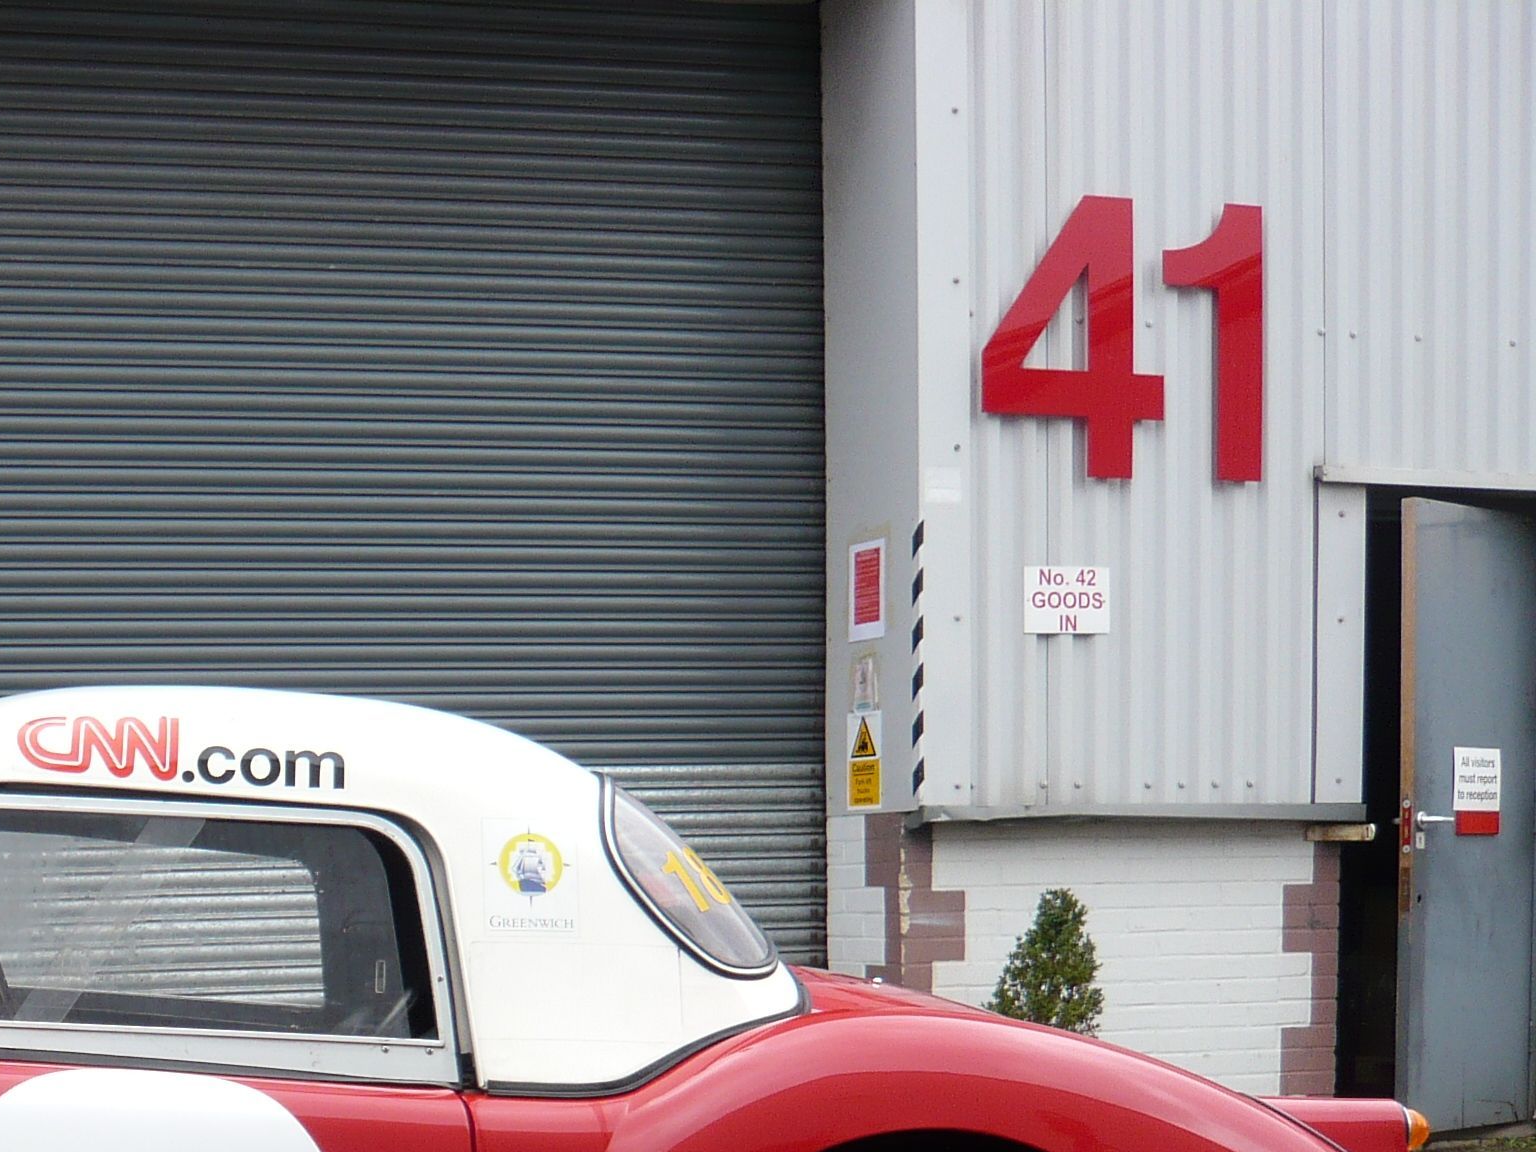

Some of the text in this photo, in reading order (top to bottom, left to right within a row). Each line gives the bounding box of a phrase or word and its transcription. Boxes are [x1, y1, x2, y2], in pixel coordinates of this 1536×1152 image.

[981, 195, 1263, 482] 41
[1038, 568, 1096, 586] No. 42
[1031, 591, 1103, 609] GOODS
[1059, 614, 1077, 631] IN
[1461, 756, 1495, 768] All visitors
[1458, 774, 1497, 786] must report
[1457, 790, 1498, 802] to reception
[662, 846, 731, 913] 18
[489, 915, 574, 929] GREENWICH
